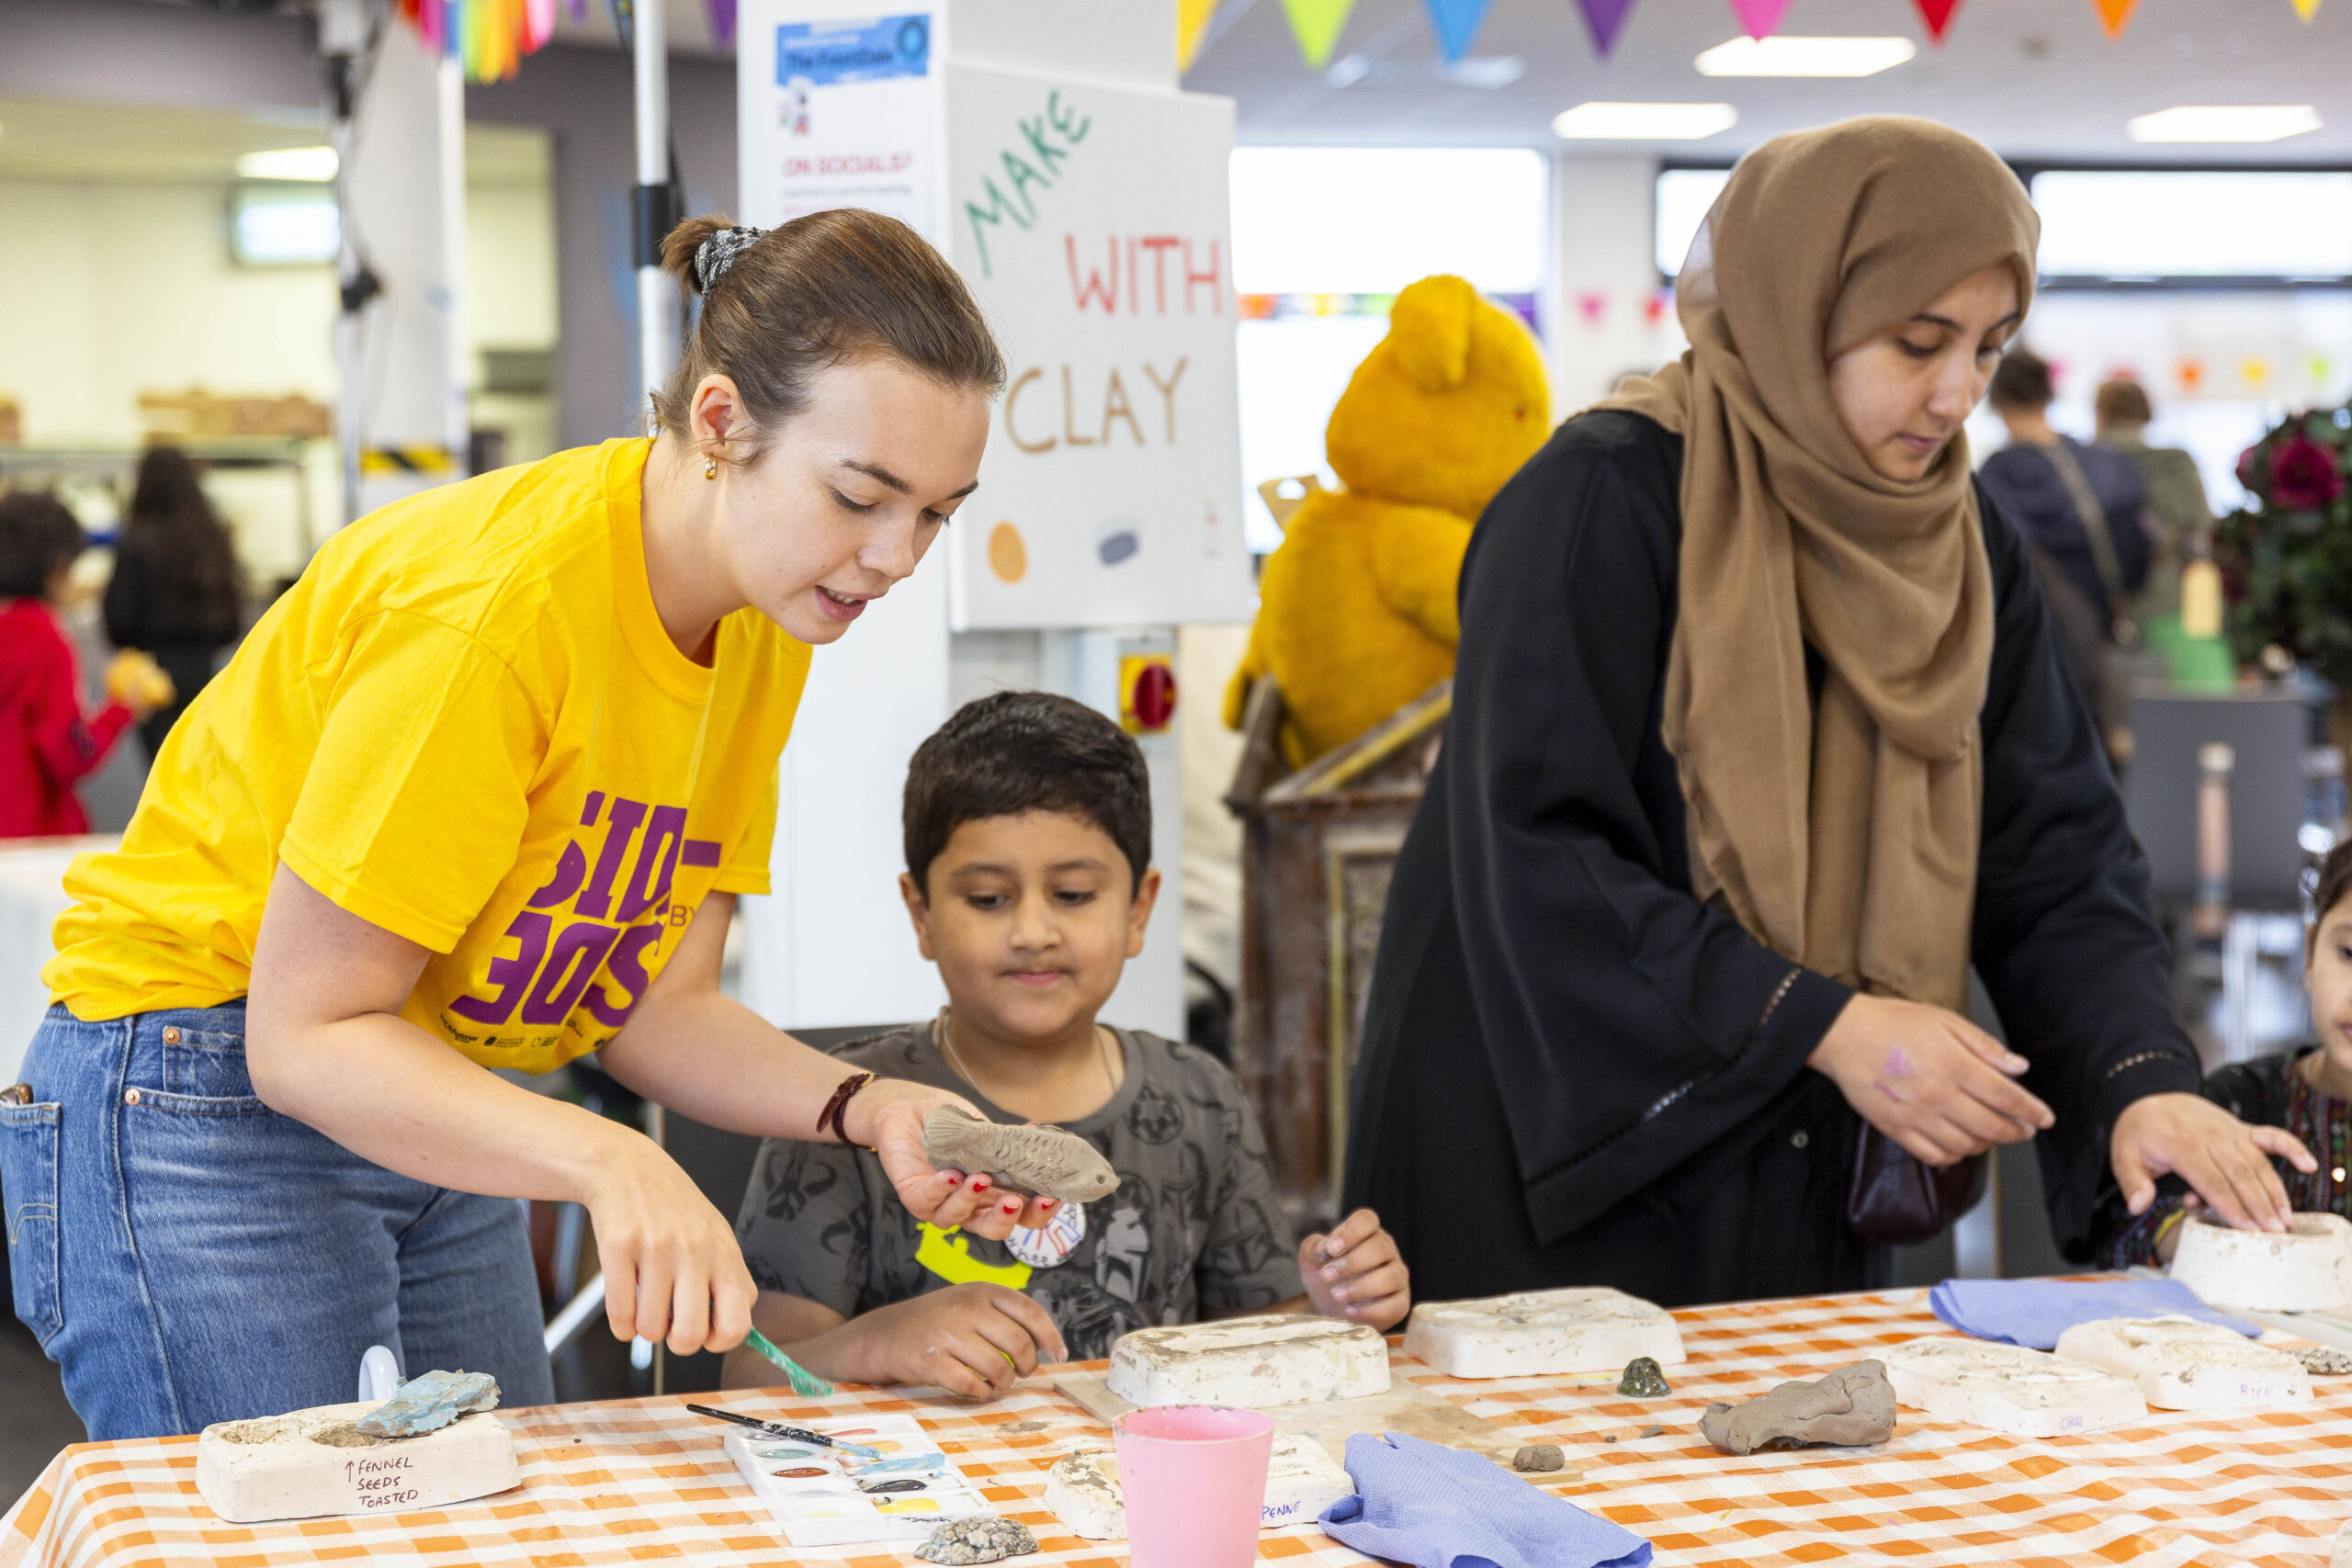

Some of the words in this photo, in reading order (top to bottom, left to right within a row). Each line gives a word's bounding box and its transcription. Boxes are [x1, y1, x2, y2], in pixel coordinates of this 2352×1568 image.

[965, 89, 1092, 280] MAKE
[1064, 232, 1223, 317] WITH
[1004, 355, 1189, 456] CLAY
[356, 1475, 401, 1491] SEEDS
[358, 1456, 413, 1475] FENNEL
[358, 1489, 419, 1508] TOASTED
